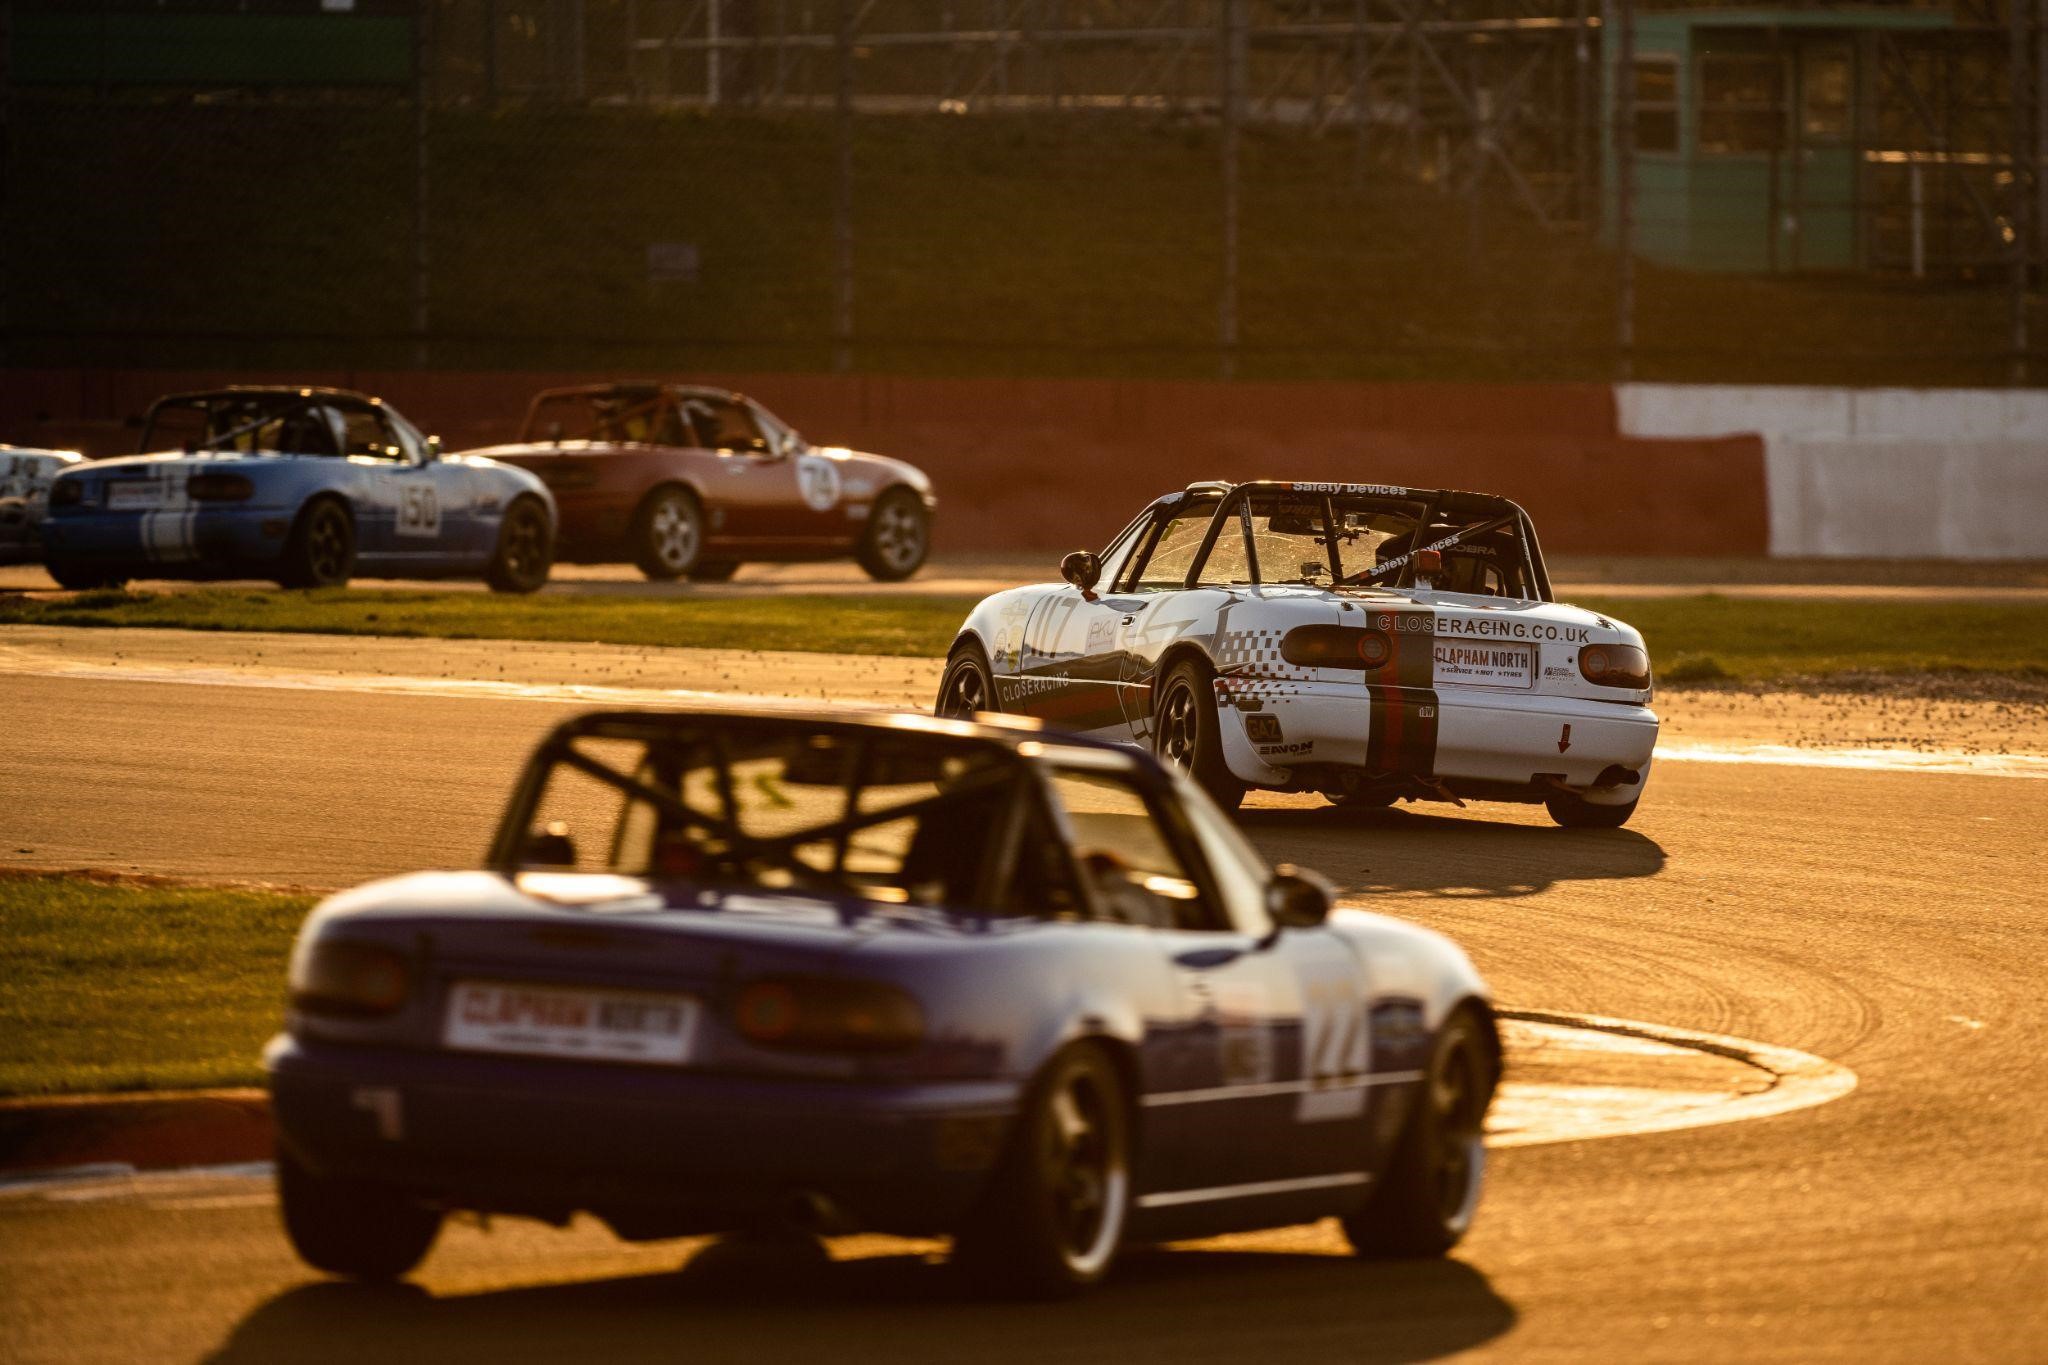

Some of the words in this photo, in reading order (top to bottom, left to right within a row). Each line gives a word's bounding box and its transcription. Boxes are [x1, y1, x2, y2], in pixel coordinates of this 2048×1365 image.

[1292, 482, 1341, 494] Safety
[1346, 484, 1407, 496] Devices
[1369, 555, 1409, 576] Safety
[1411, 534, 1460, 556] vices
[1377, 614, 1590, 643] CLOSERACING.CO.UK
[1434, 647, 1489, 666] CLAPHAM
[1491, 651, 1528, 668] NORTH
[1446, 666, 1473, 675] SERVICE
[1003, 671, 1070, 703] CLOSERACING
